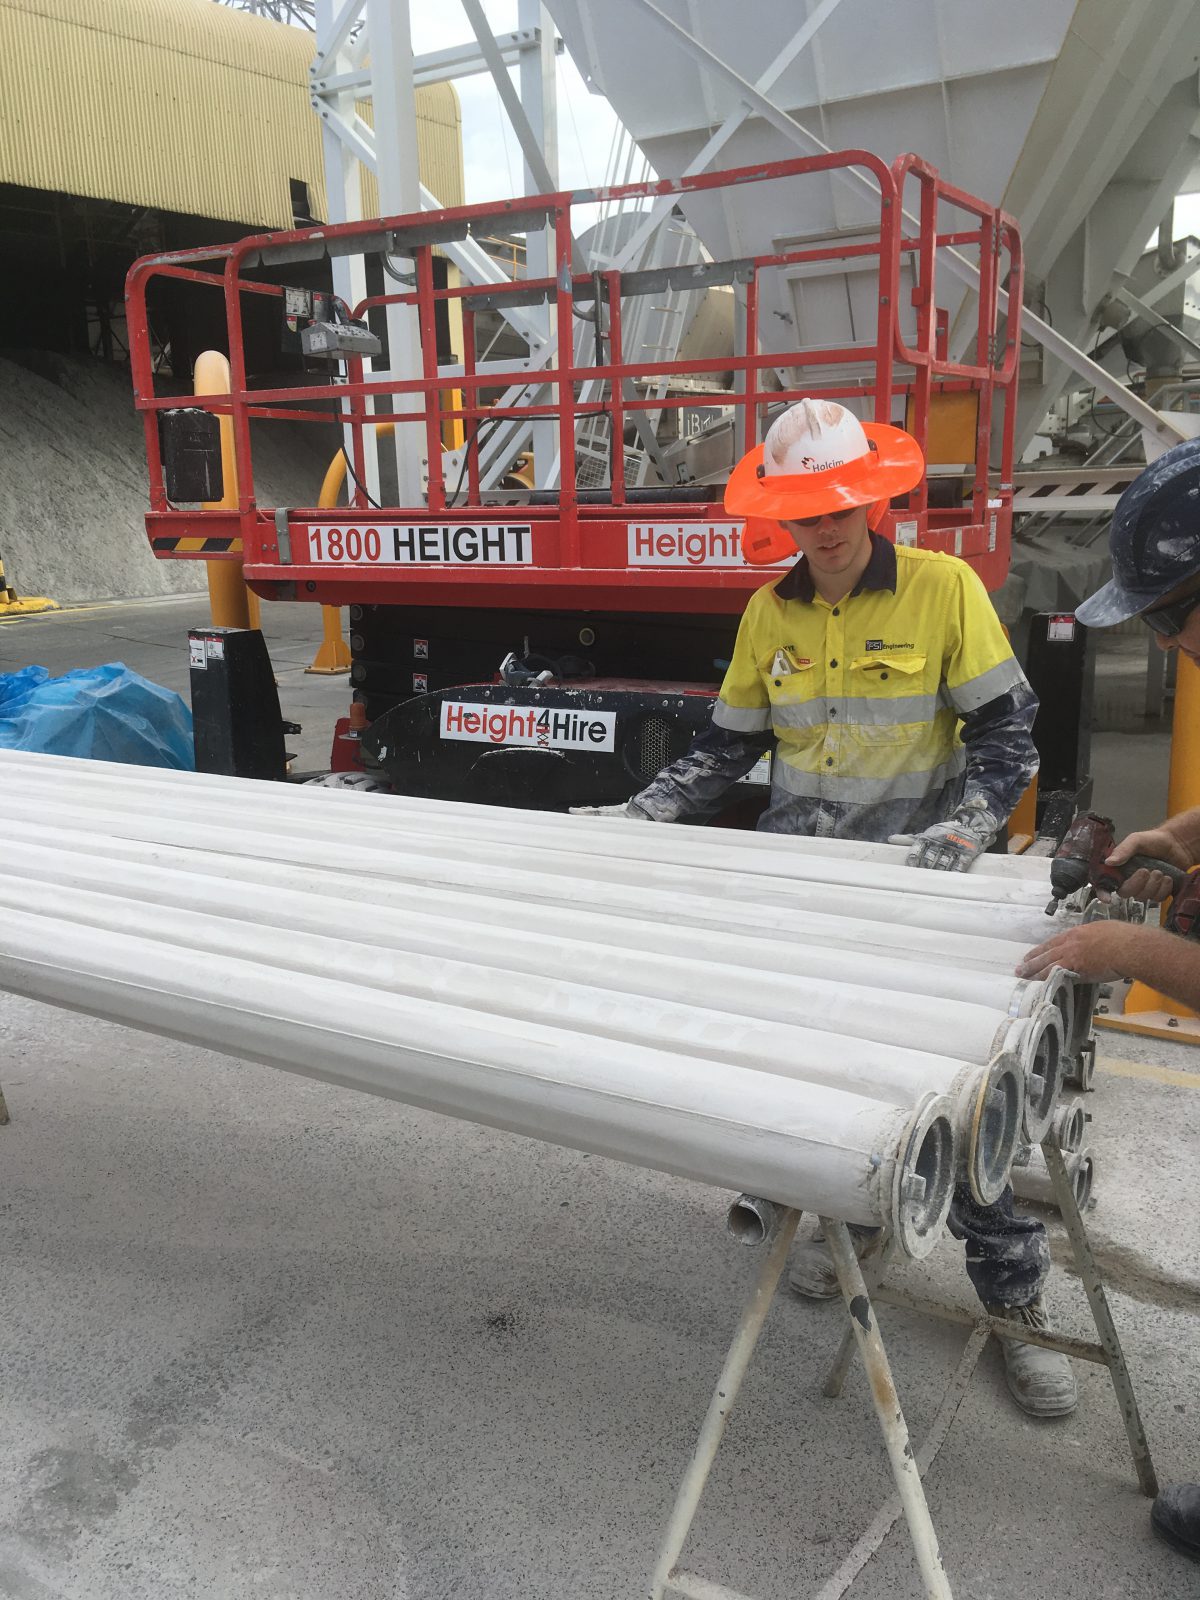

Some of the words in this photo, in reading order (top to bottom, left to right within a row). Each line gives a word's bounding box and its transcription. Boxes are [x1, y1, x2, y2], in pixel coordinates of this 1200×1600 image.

[813, 459, 844, 472] Holcim
[310, 528, 381, 561] 1800
[393, 527, 530, 562] HEIGHT
[635, 527, 742, 564] Height
